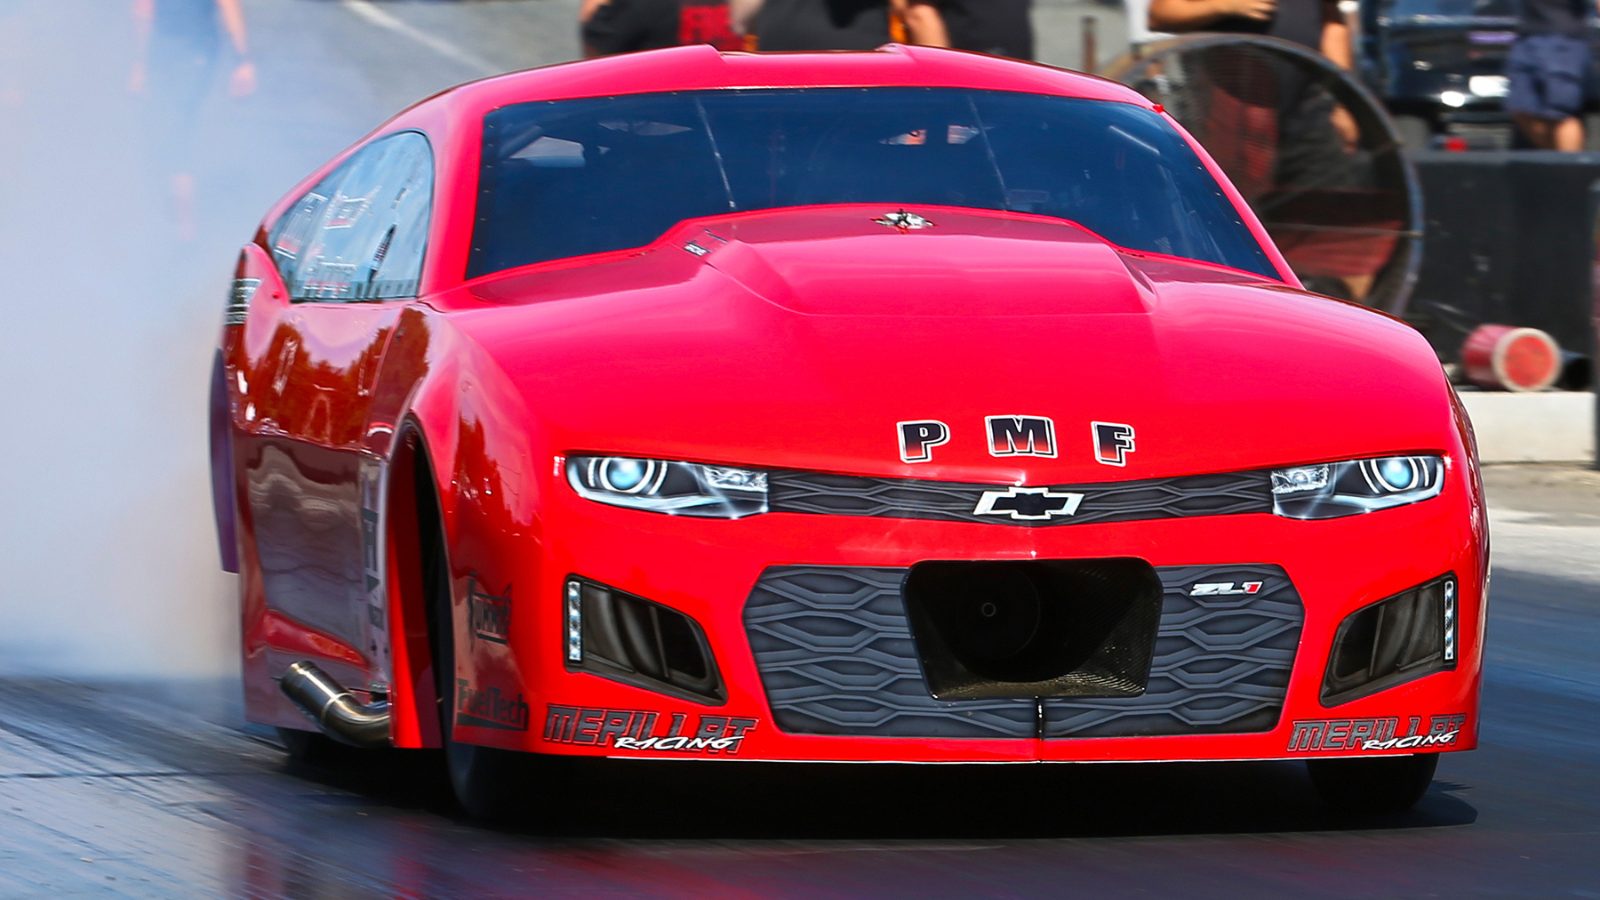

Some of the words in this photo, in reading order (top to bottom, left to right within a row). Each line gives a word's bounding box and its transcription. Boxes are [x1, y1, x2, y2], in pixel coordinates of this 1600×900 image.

[1189, 581, 1264, 597] ZL1
[613, 735, 744, 751] RACING
[1361, 729, 1460, 751] RACING
